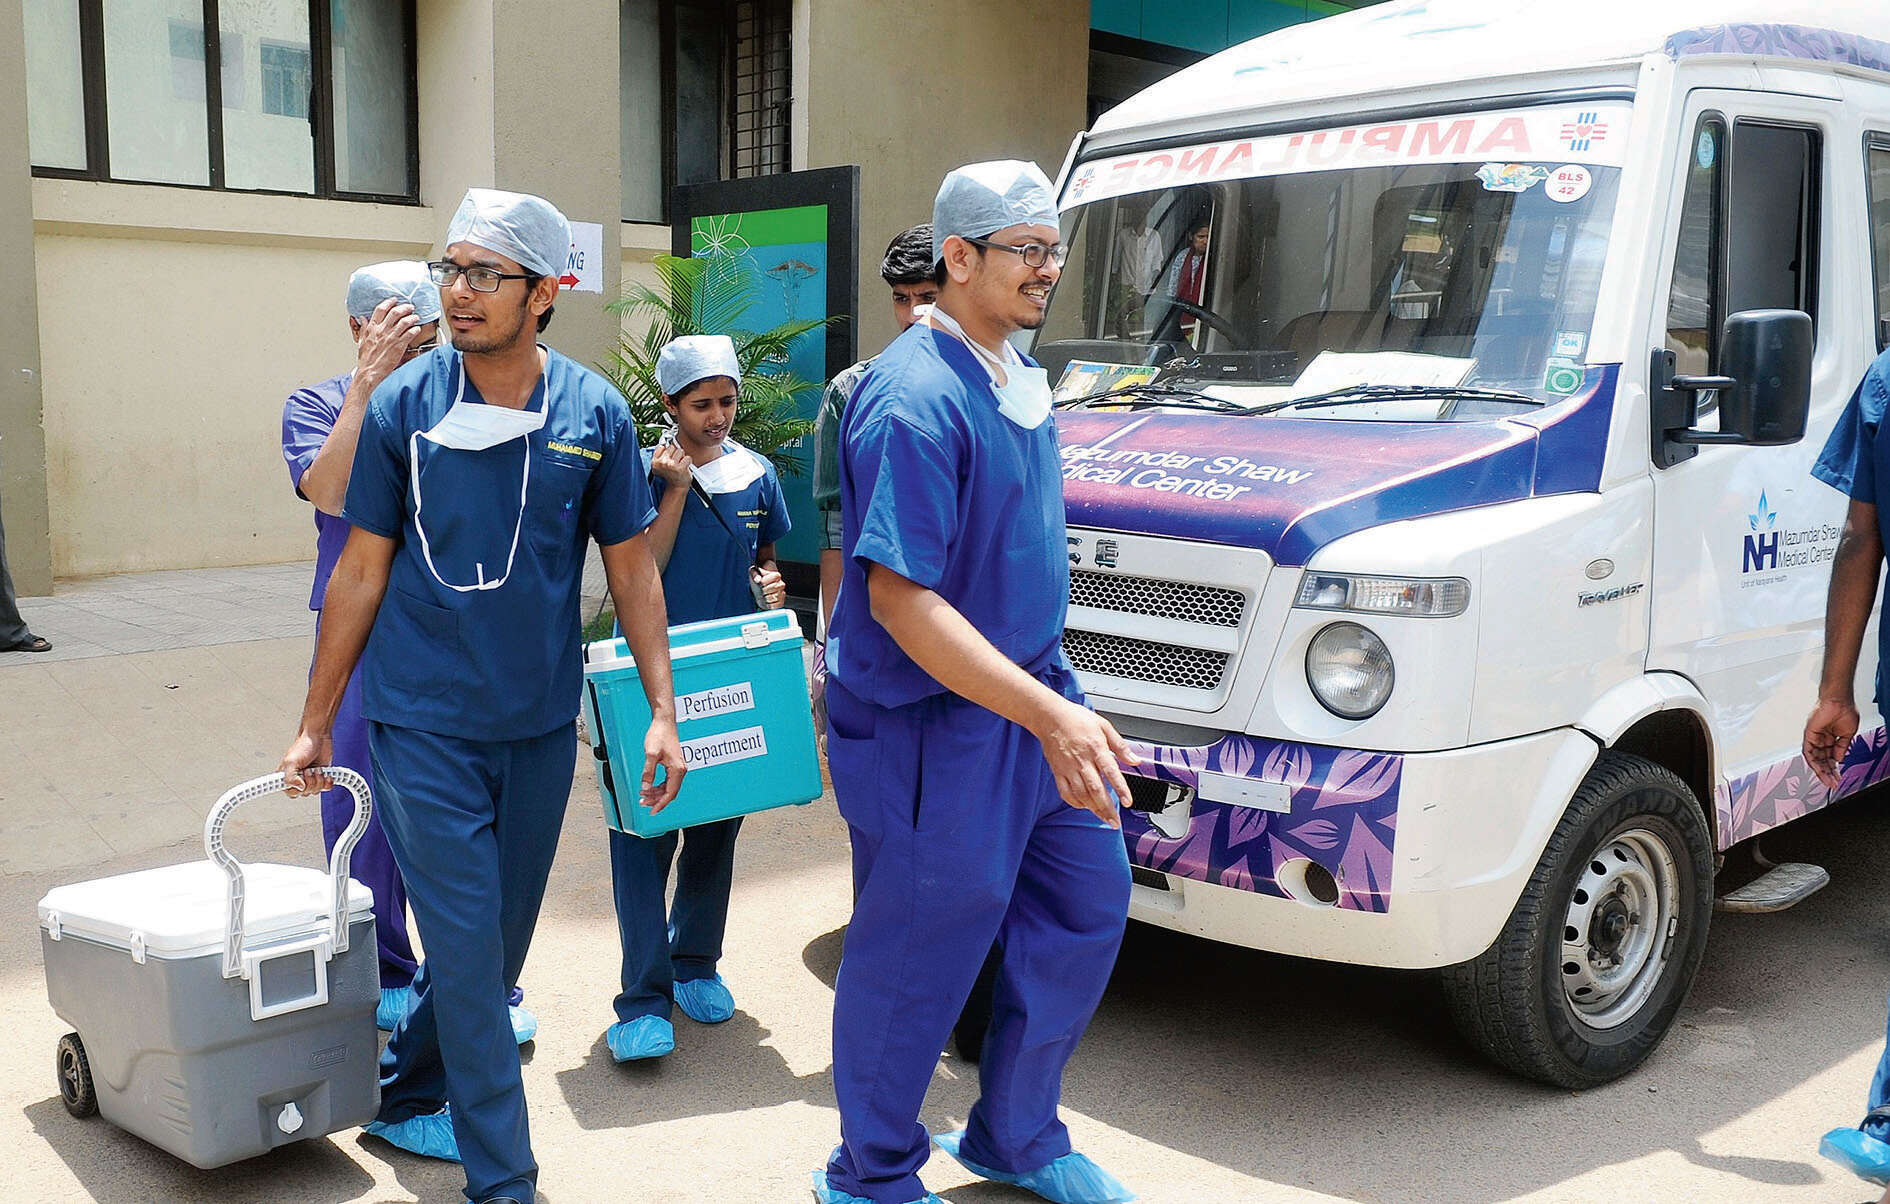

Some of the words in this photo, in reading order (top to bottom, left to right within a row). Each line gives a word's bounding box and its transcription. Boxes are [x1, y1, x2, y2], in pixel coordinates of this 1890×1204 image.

[1557, 172, 1585, 182] BLS
[1557, 186, 1575, 195] 42
[1061, 462, 1130, 484] dical
[1130, 468, 1252, 502] Center
[1203, 455, 1314, 485] Shaw
[1779, 526, 1820, 547] Mazumdar
[1742, 531, 1779, 573] NH
[1777, 550, 1809, 569] Medical
[1809, 545, 1835, 564] Center
[684, 688, 749, 715] Perfusion
[681, 733, 762, 765] Department
